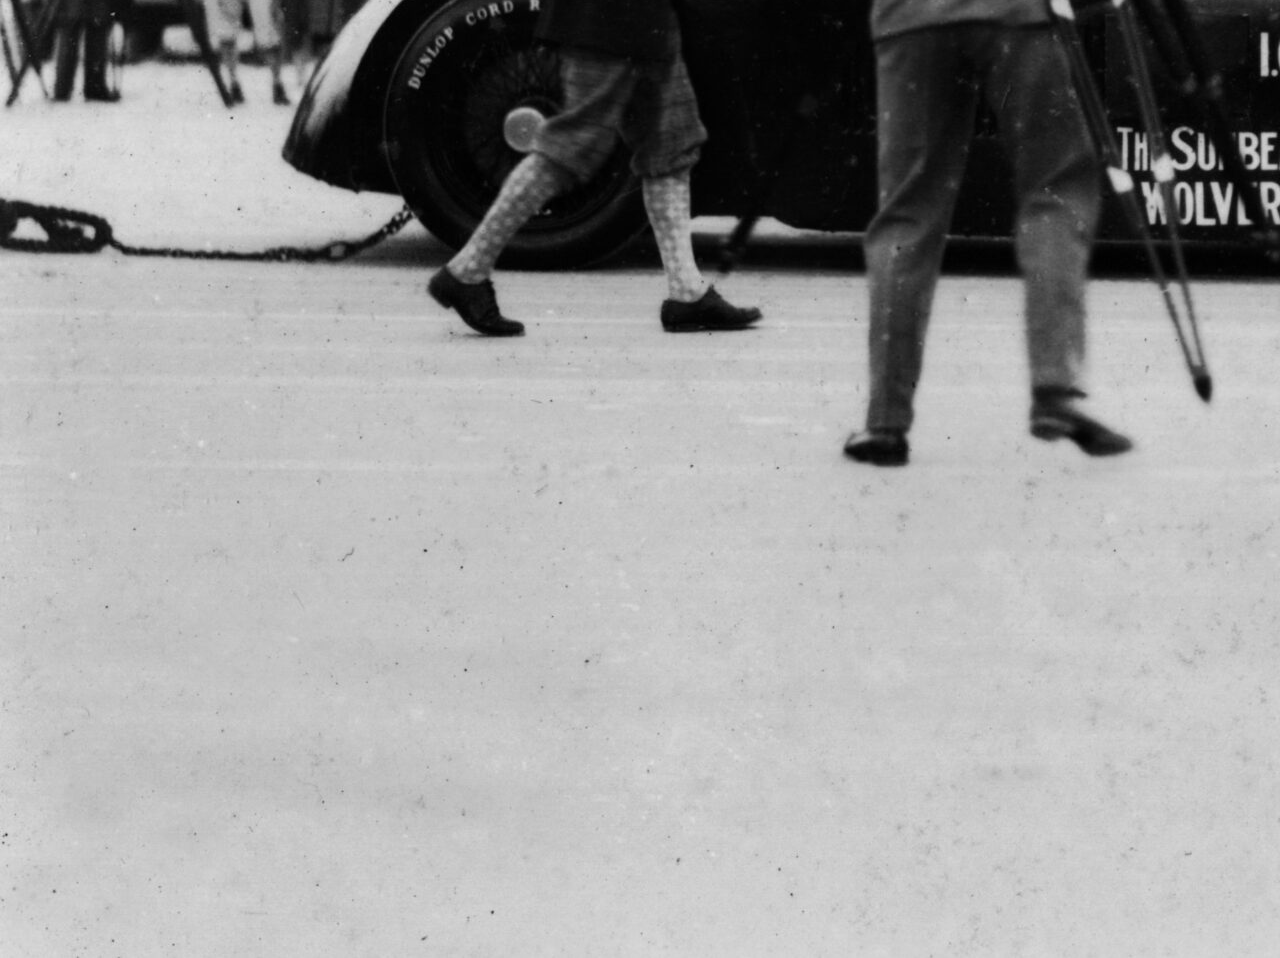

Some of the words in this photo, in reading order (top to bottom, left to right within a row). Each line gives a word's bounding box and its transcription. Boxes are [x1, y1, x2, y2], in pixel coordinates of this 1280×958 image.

[407, 26, 454, 90] DUNLOP
[465, 0, 515, 26] CORD
[1116, 126, 1163, 172] TH
